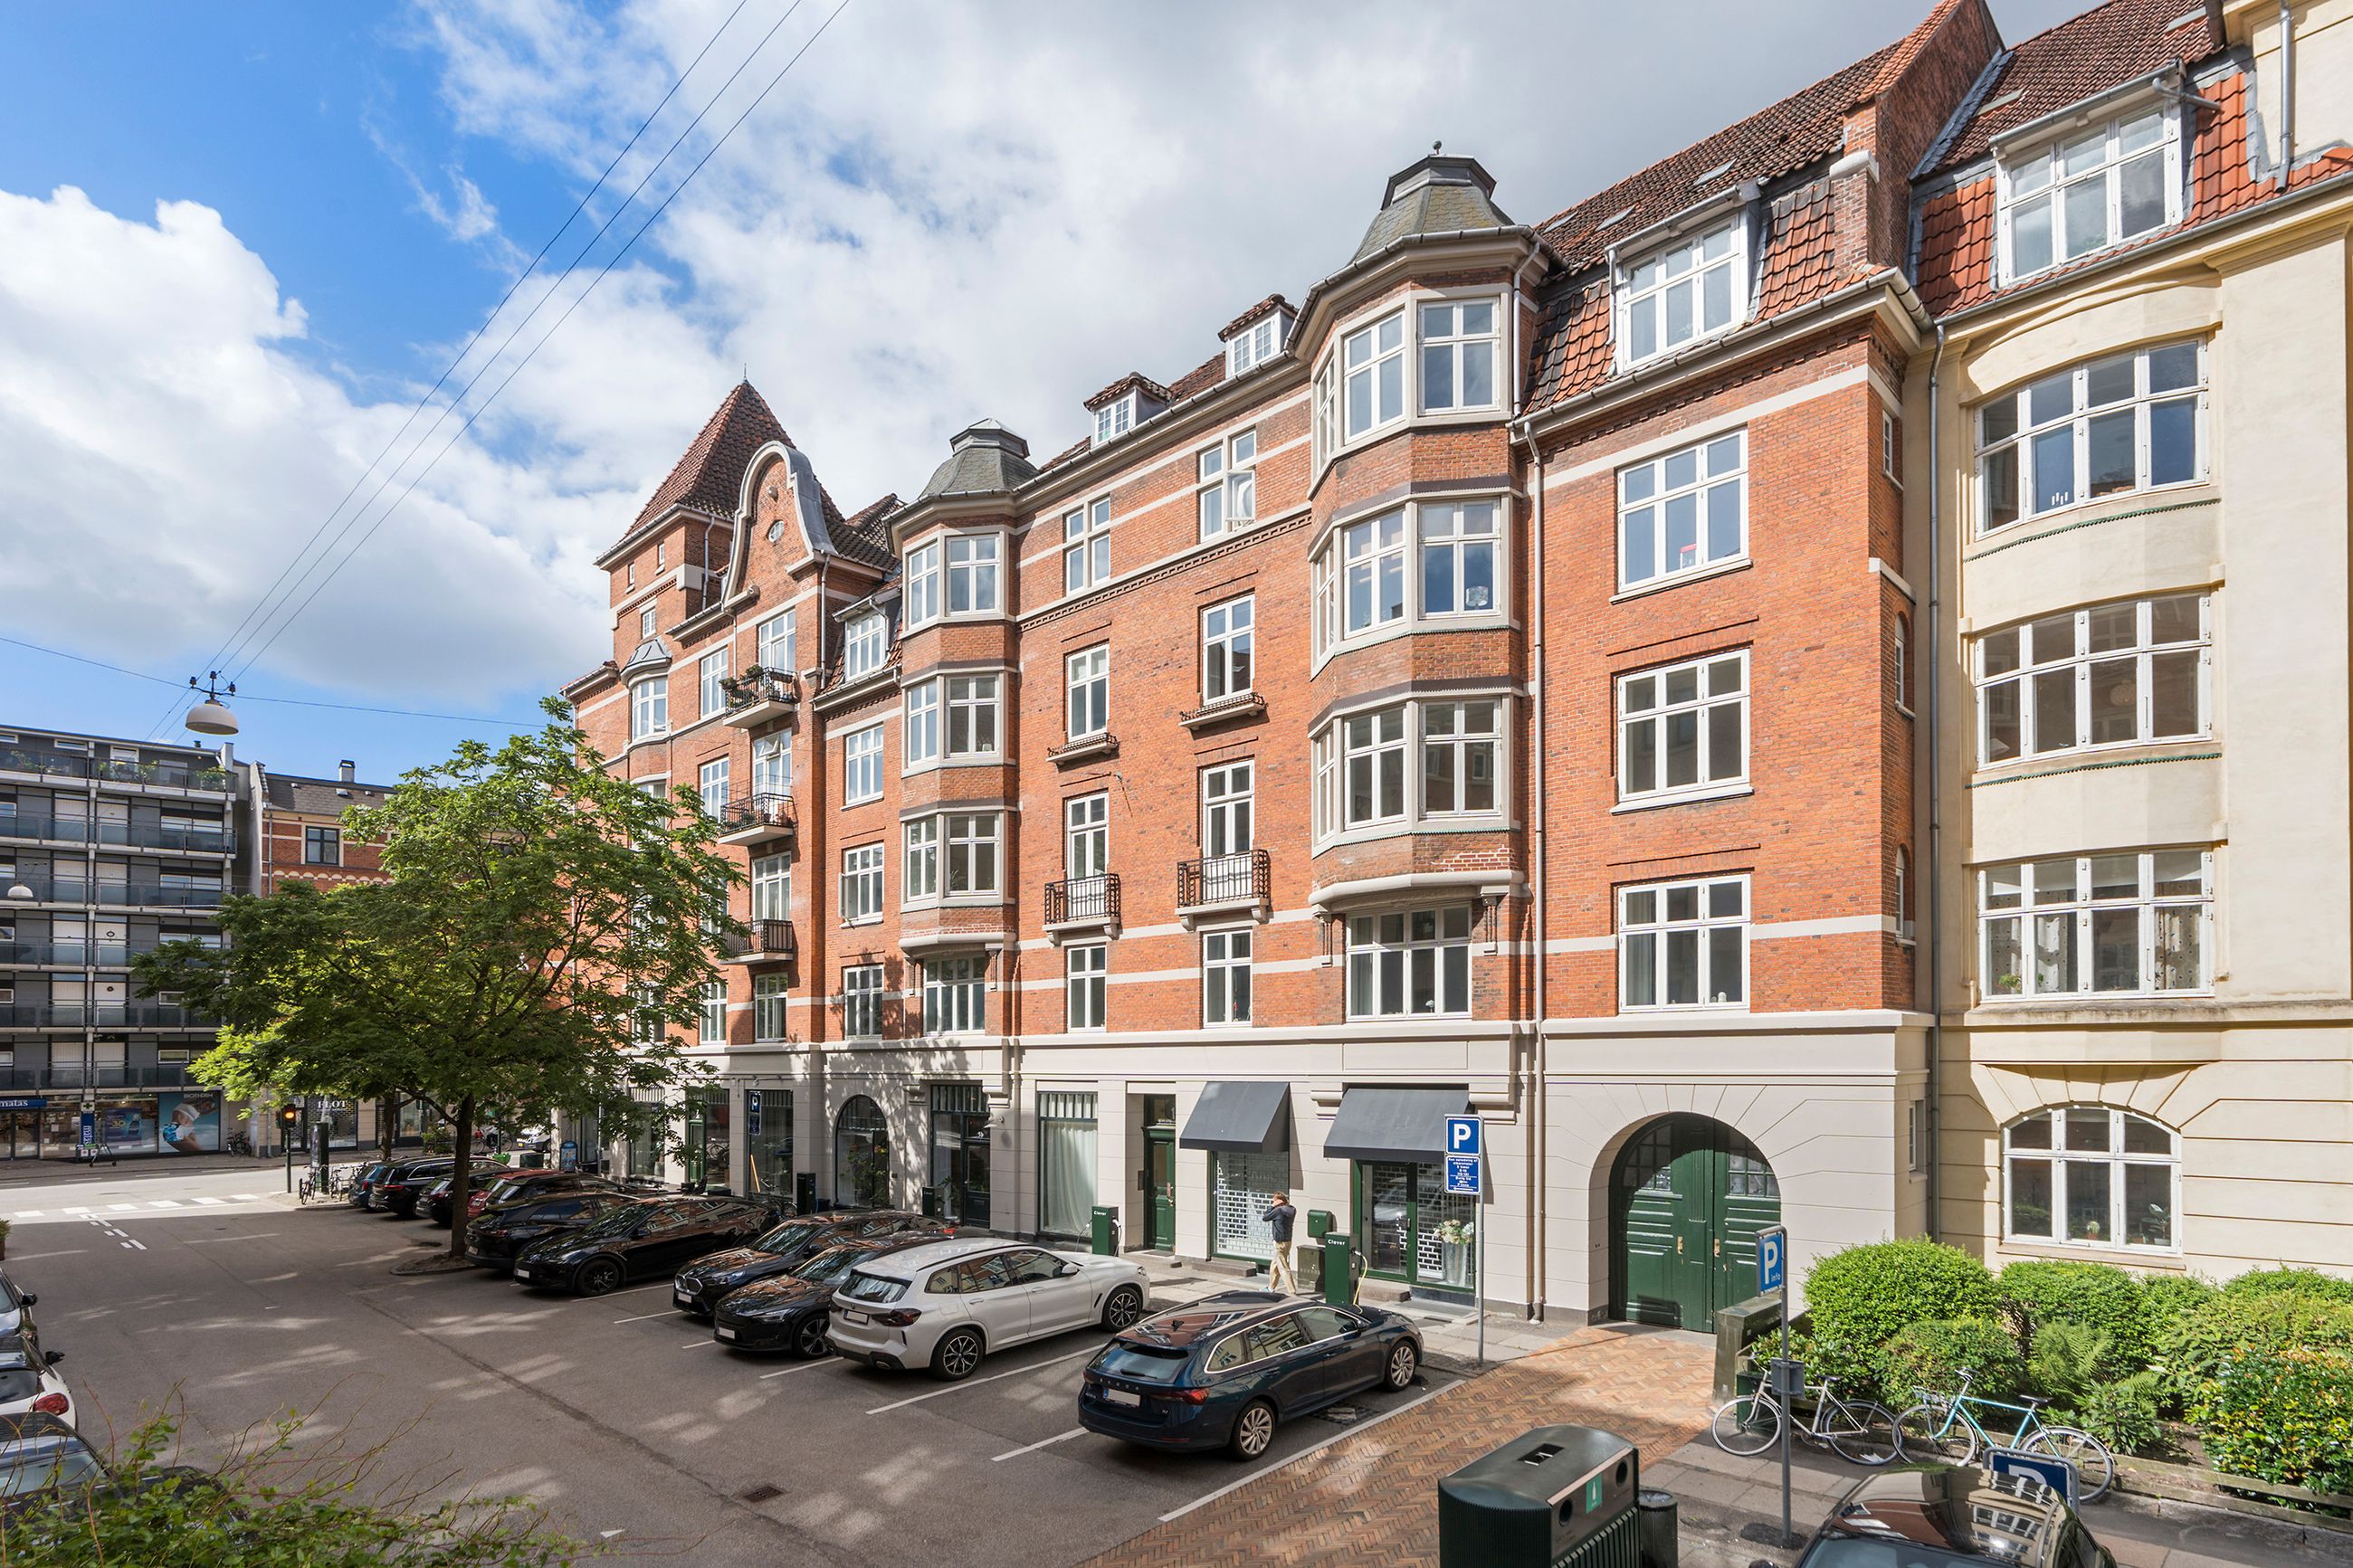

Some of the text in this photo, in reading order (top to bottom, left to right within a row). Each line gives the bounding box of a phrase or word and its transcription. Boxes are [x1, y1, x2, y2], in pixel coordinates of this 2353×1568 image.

[0, 1099, 28, 1107] matas
[752, 1096, 758, 1111] P
[1453, 1123, 1472, 1149] P
[1764, 1240, 1778, 1285] P
